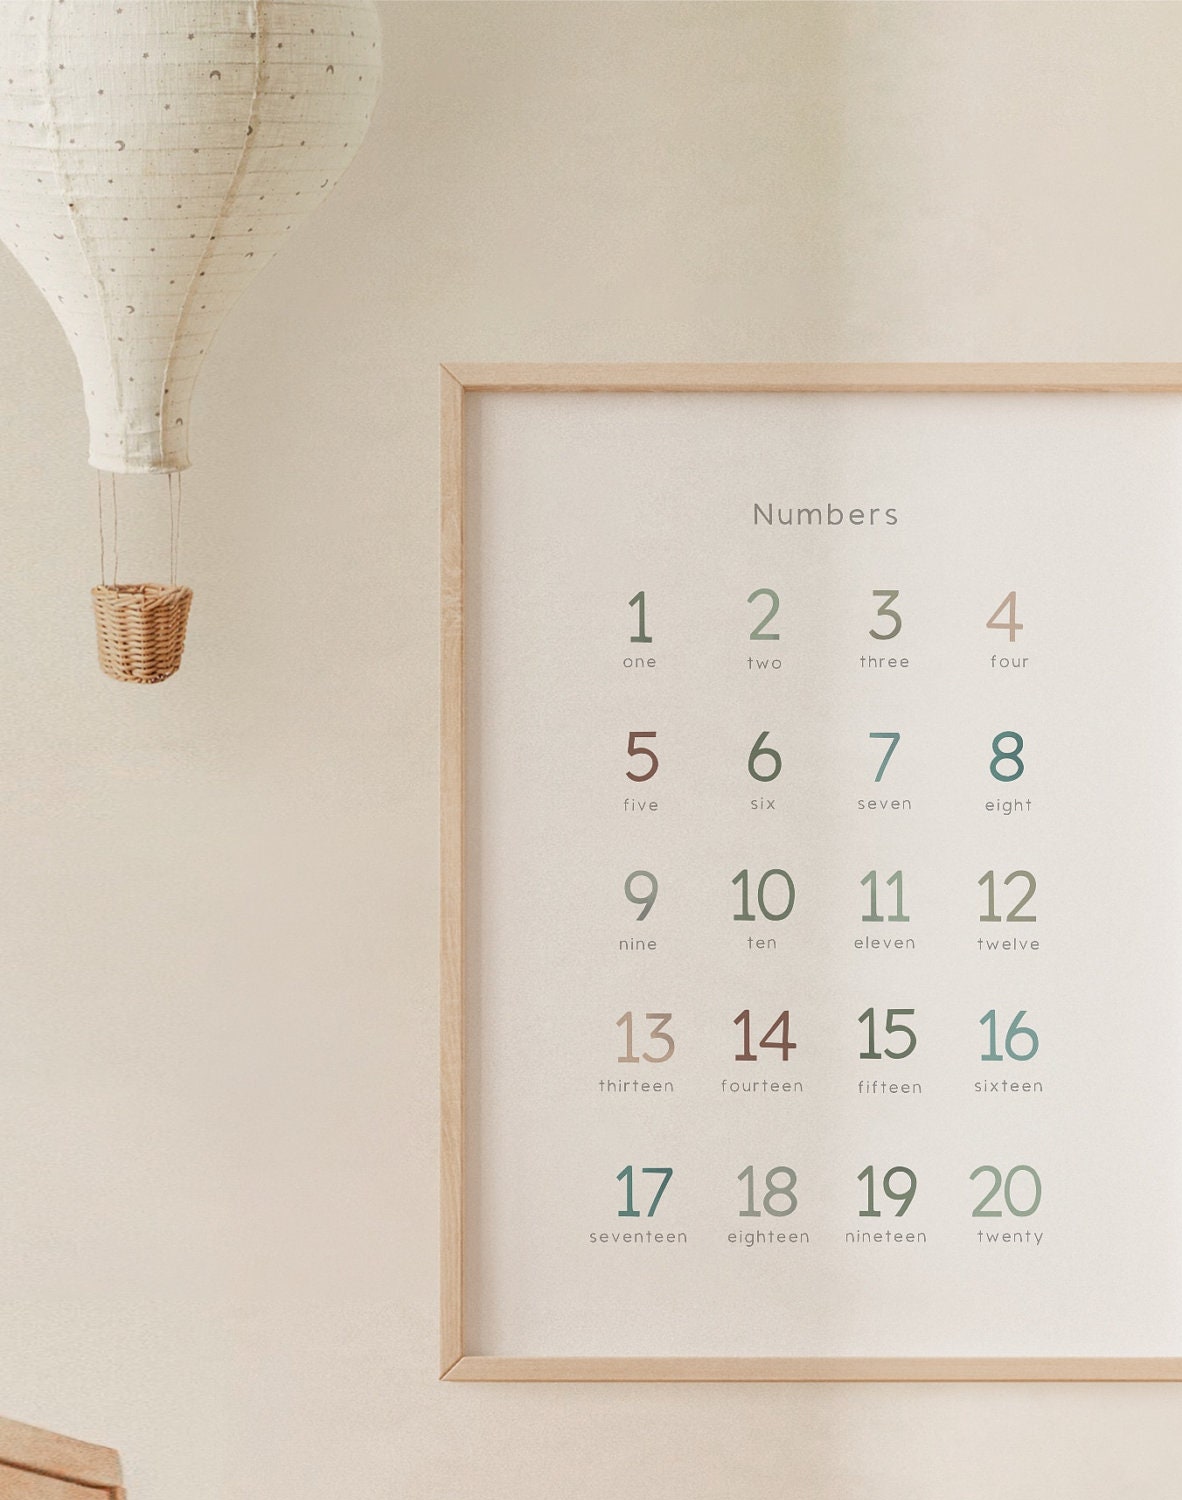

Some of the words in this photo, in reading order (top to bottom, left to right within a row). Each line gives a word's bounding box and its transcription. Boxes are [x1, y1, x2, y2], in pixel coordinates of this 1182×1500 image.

[753, 502, 899, 526] Numbers
[627, 590, 654, 644] 1
[746, 587, 781, 641] 2
[868, 589, 903, 641] 3
[985, 590, 1024, 643] 4
[622, 657, 657, 669] one
[746, 655, 782, 670] two
[859, 655, 910, 669] three
[990, 654, 1029, 669] four
[625, 730, 660, 783] 5
[747, 730, 783, 783] 6
[868, 731, 902, 783] 7
[988, 730, 1025, 783] 8
[623, 796, 659, 812] five
[750, 797, 776, 811] six
[857, 799, 912, 811] seven
[984, 798, 1032, 816] eight
[623, 869, 659, 922] 9
[730, 867, 796, 922] 10
[859, 869, 911, 923] 11
[977, 869, 1038, 923] 12
[618, 937, 658, 951] nine
[746, 935, 777, 950] ten
[853, 935, 916, 950] eleven
[976, 936, 1040, 951] twelve
[615, 1010, 676, 1064] 13
[732, 1008, 798, 1063] 14
[857, 1006, 918, 1061] 15
[978, 1008, 1040, 1062] 16
[598, 1078, 675, 1093] thirteen
[720, 1078, 804, 1094] fourteen
[857, 1078, 923, 1095] fifteen
[973, 1078, 1044, 1093] sixteen
[615, 1164, 674, 1218] 17
[736, 1164, 799, 1218] 18
[856, 1164, 918, 1218] 19
[968, 1164, 1043, 1218] 20
[589, 1229, 688, 1244] seventeen
[727, 1228, 810, 1248] eighteen
[845, 1228, 927, 1243] nineteen
[976, 1228, 1044, 1246] twenty
